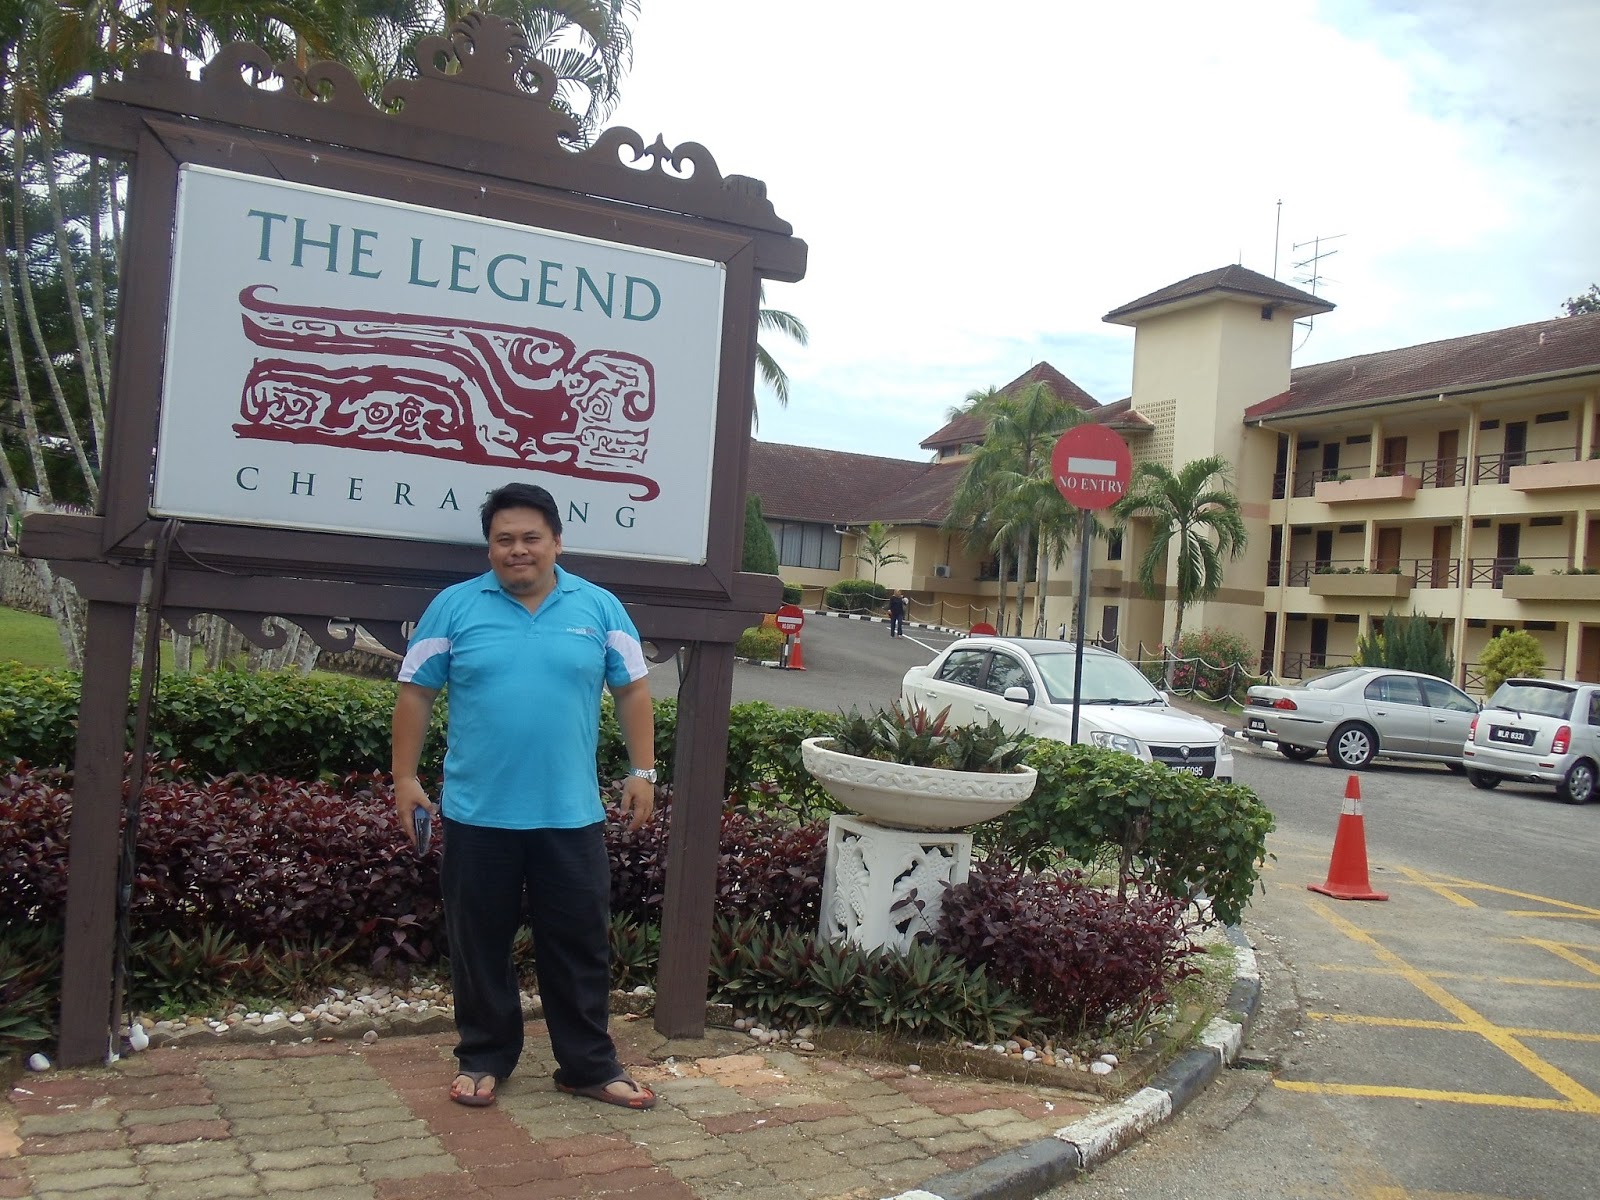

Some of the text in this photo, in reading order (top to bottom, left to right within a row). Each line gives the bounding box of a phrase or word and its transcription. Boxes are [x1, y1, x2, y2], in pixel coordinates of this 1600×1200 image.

[248, 209, 662, 322] THE LEGEND
[235, 465, 637, 529] CHERANG
[1059, 475, 1124, 493] NO ENTRY
